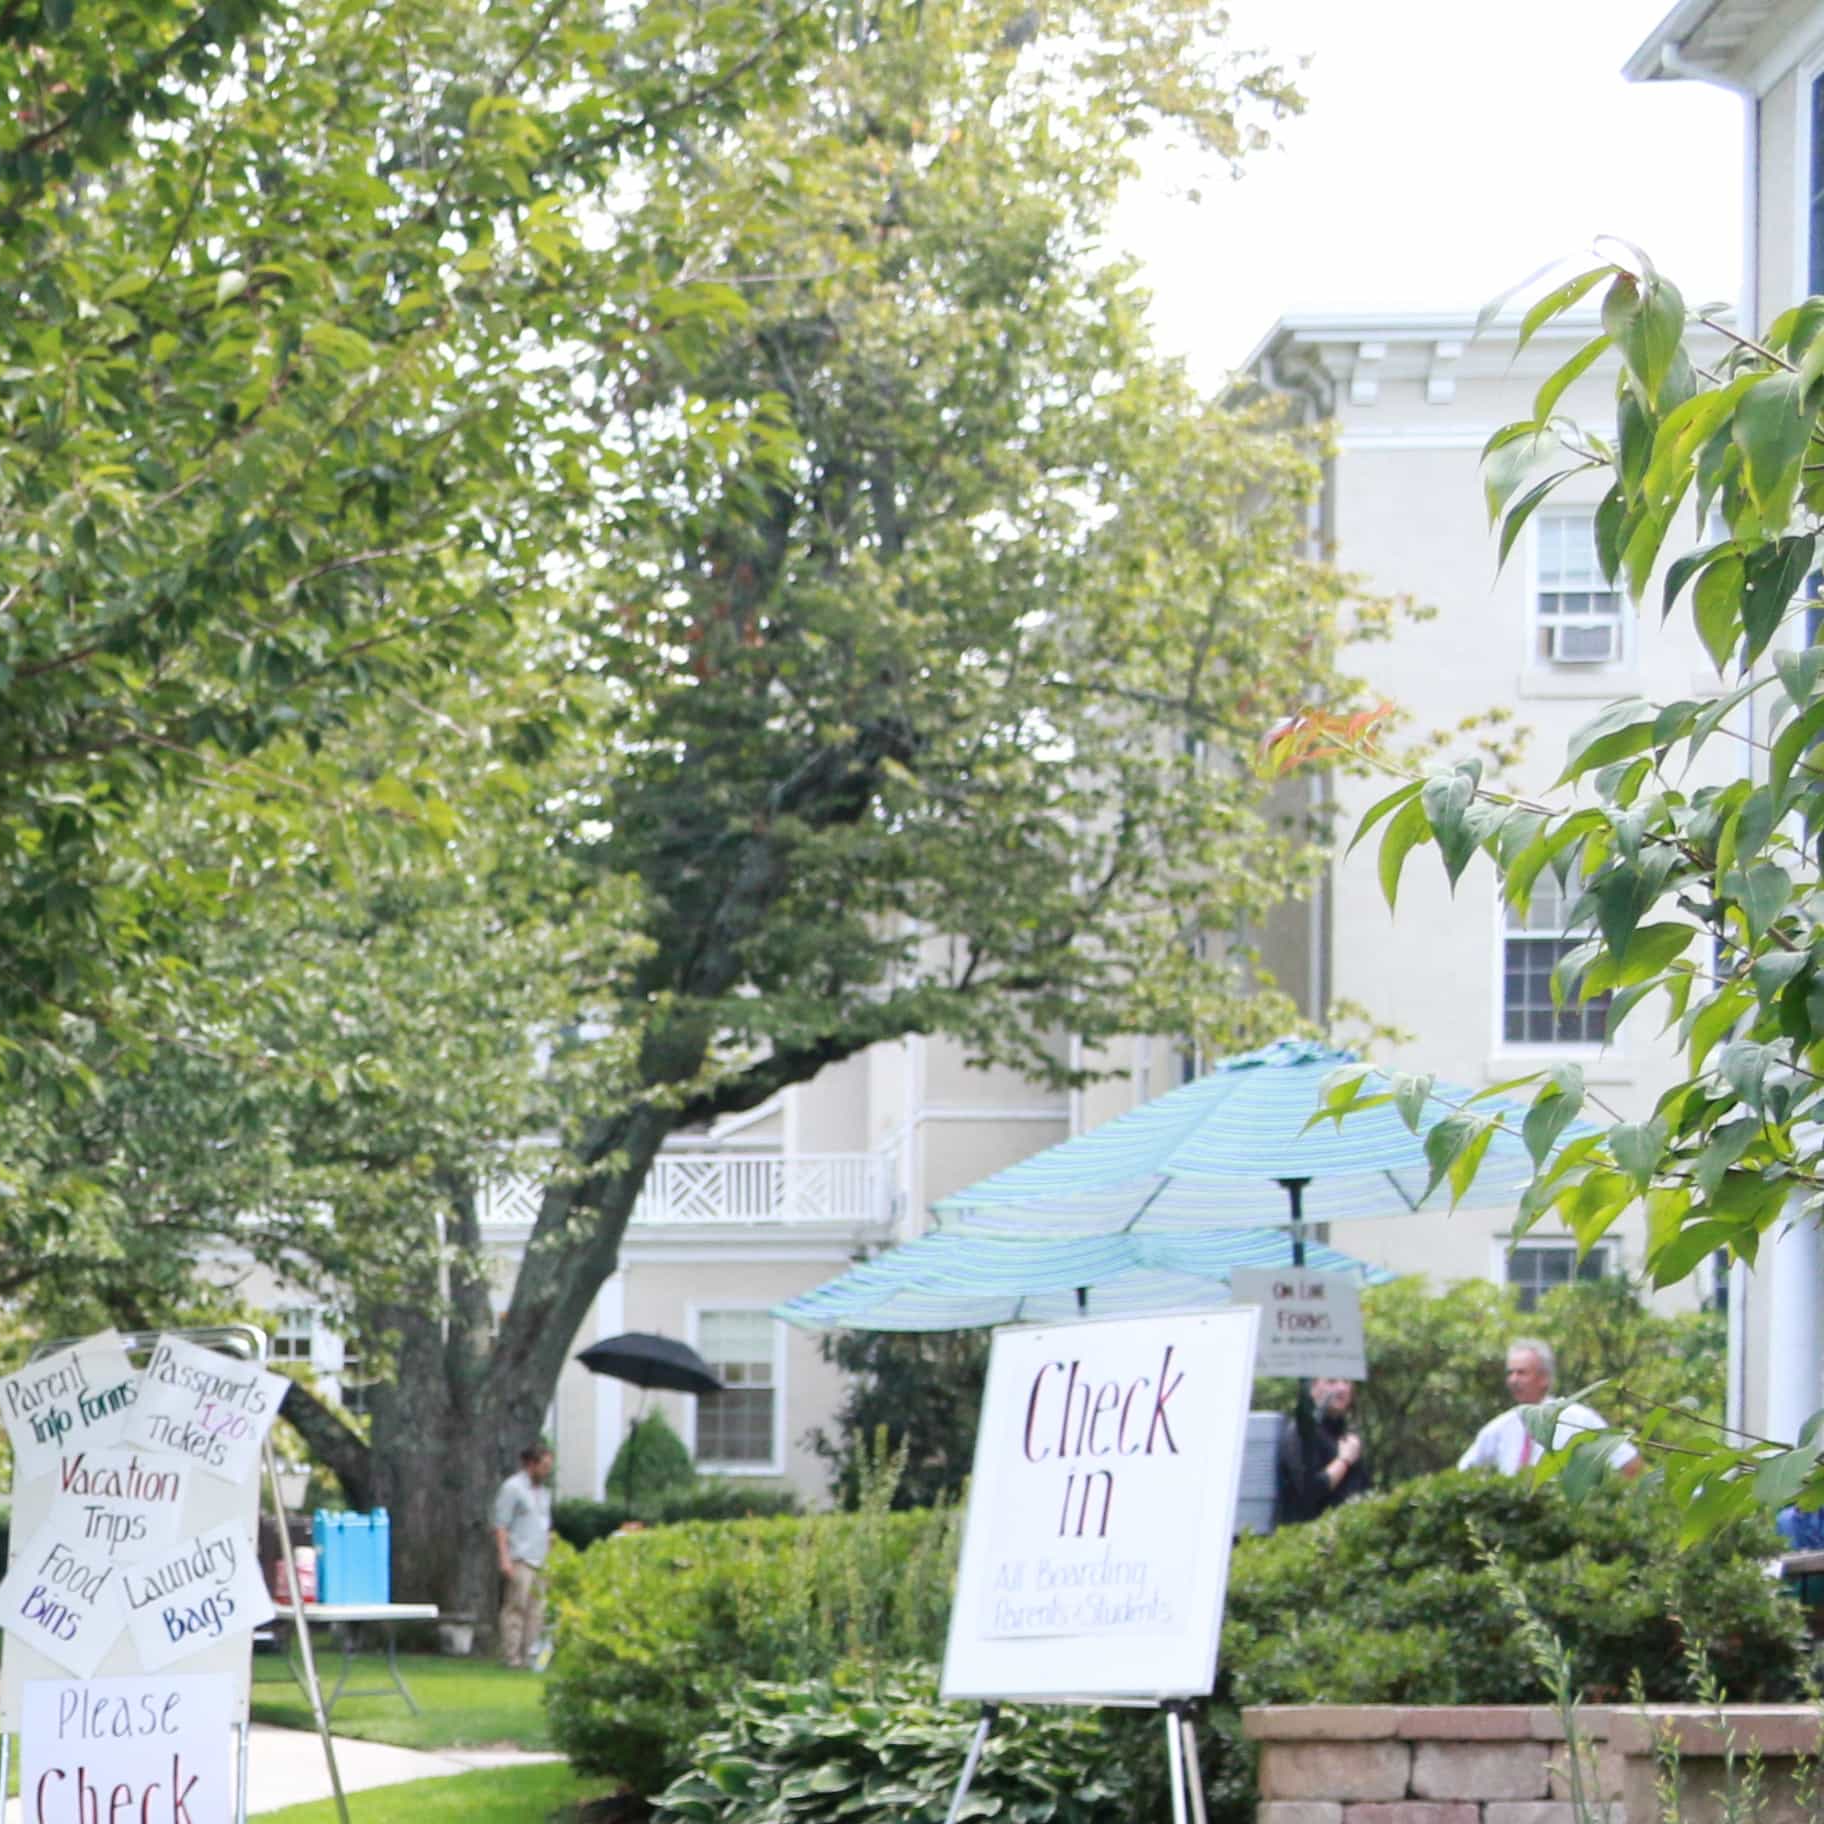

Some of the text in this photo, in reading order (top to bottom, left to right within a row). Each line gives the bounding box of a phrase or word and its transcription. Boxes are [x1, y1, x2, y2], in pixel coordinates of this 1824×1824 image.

[5, 1352, 89, 1418] Parent
[148, 1345, 268, 1416] Passports
[1023, 1344, 1184, 1464] Check
[30, 1406, 73, 1448] Info
[148, 1414, 228, 1467] Tickets
[59, 1451, 181, 1502] Vacation
[1057, 1465, 1114, 1538] in
[84, 1505, 148, 1556] Trips
[37, 1542, 112, 1605] Food
[121, 1536, 238, 1610] Laundry
[20, 1584, 82, 1642] Bins
[162, 1586, 236, 1642] Bags
[58, 1687, 181, 1739] Please
